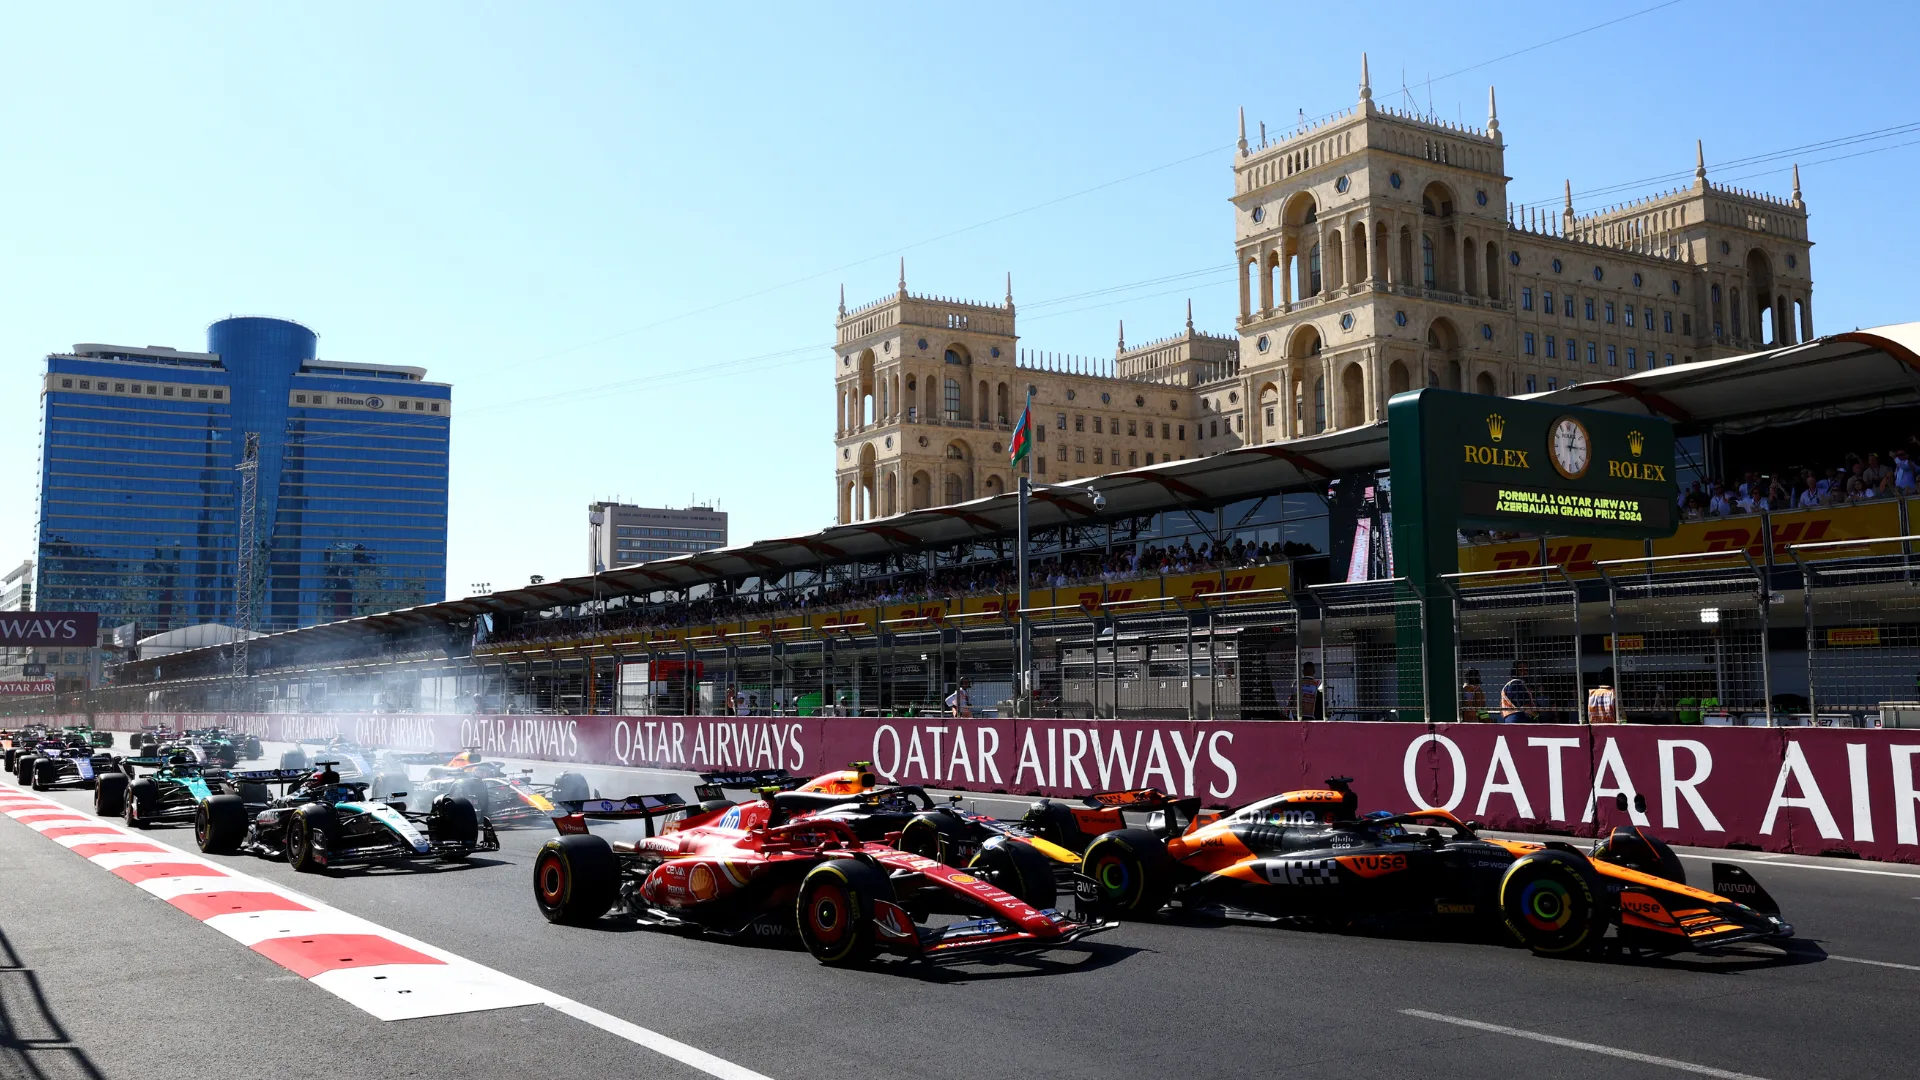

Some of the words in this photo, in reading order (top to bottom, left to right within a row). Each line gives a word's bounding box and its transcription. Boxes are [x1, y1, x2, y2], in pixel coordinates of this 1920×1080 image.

[336, 397, 364, 406] Hilton
[1464, 445, 1530, 468] ROLEX
[1608, 460, 1666, 482] ROLEX
[1496, 501, 1558, 515] AZERBAIJAN
[1560, 506, 1594, 518] GRAND
[1595, 508, 1617, 520] PRIX
[1618, 510, 1642, 522] 2024
[1499, 490, 1548, 504] FORMULA
[1549, 494, 1555, 504] 1
[1557, 495, 1591, 508] QATAR
[1593, 498, 1638, 511] AIRWAYS
[1703, 520, 1831, 554] DHL
[1494, 543, 1592, 577] DHL
[1078, 588, 1132, 610] DHL
[1191, 575, 1255, 601] DHL
[900, 607, 942, 627] DHL
[982, 600, 1019, 619] DHL
[825, 615, 860, 633] DHL
[281, 716, 305, 741] QATAR
[306, 716, 339, 740] AIRWAYS
[355, 718, 388, 746] QATAR
[389, 718, 435, 748] AIRWAYS
[460, 718, 507, 754] QATAR
[510, 720, 578, 757] AIRWAYS
[614, 721, 686, 765] QATAR
[692, 722, 804, 771] AIRWAYS
[872, 724, 1003, 784] QATAR
[1015, 726, 1238, 798] AIRWAYS
[698, 788, 716, 797] Mobil
[1403, 734, 1725, 832] QATAR
[1201, 838, 1225, 848] DELL
[1352, 856, 1405, 871] vuse
[1077, 880, 1098, 894] aws
[1564, 865, 1593, 903] ZERO
[754, 924, 783, 936] VGW
[947, 938, 993, 948] V-Power
